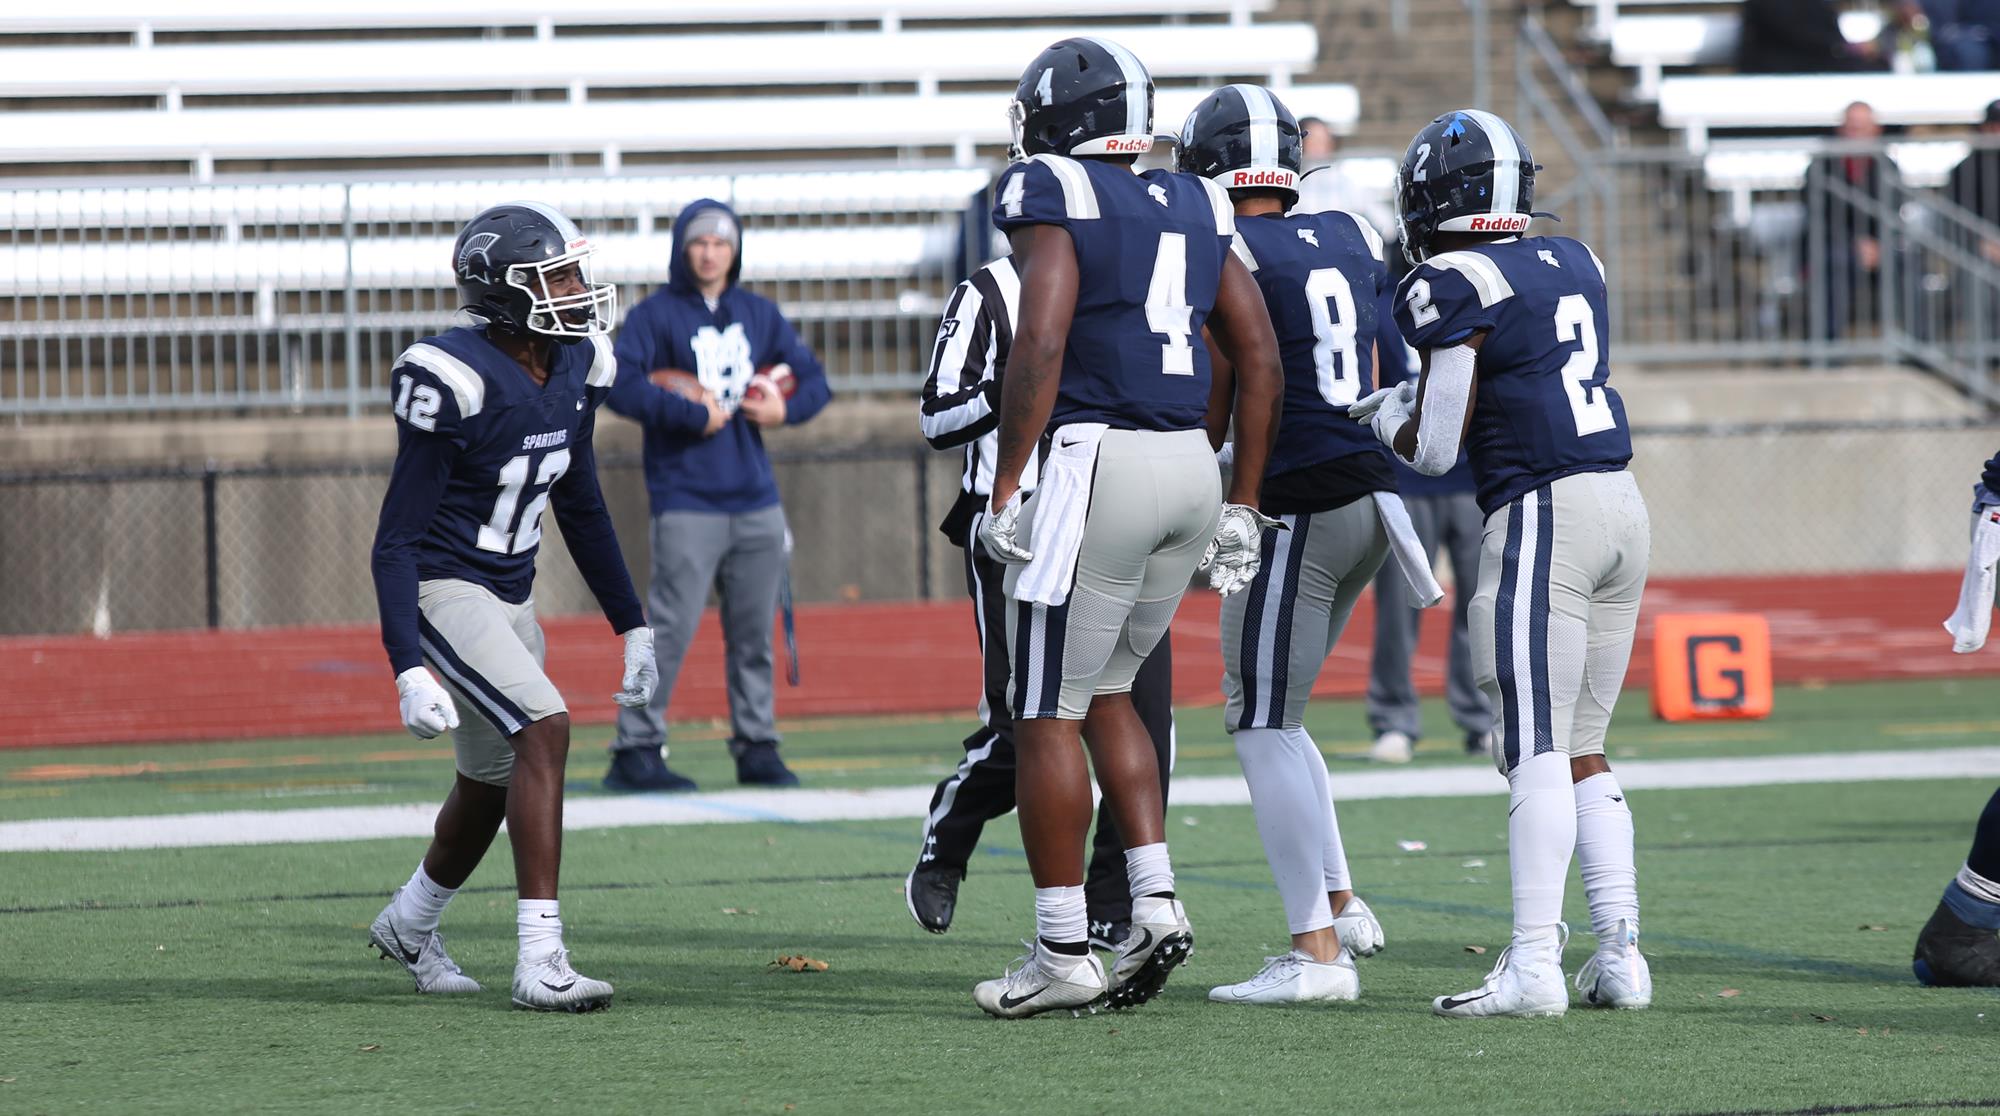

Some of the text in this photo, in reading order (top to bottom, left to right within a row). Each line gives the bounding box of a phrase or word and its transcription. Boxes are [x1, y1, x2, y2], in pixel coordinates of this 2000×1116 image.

[1033, 67, 1055, 106] 4
[1233, 171, 1293, 187] Riddell
[1412, 143, 1431, 182] 2
[1000, 172, 1026, 219] 4
[1470, 217, 1528, 231] Riddell
[1144, 231, 1195, 377] 4
[1406, 278, 1441, 330] 2
[1304, 267, 1362, 407] 8
[1553, 293, 1617, 438] 2
[393, 374, 442, 432] 12
[522, 428, 568, 450] SPARTANS
[475, 447, 571, 555] 12
[1686, 635, 1746, 707] G
